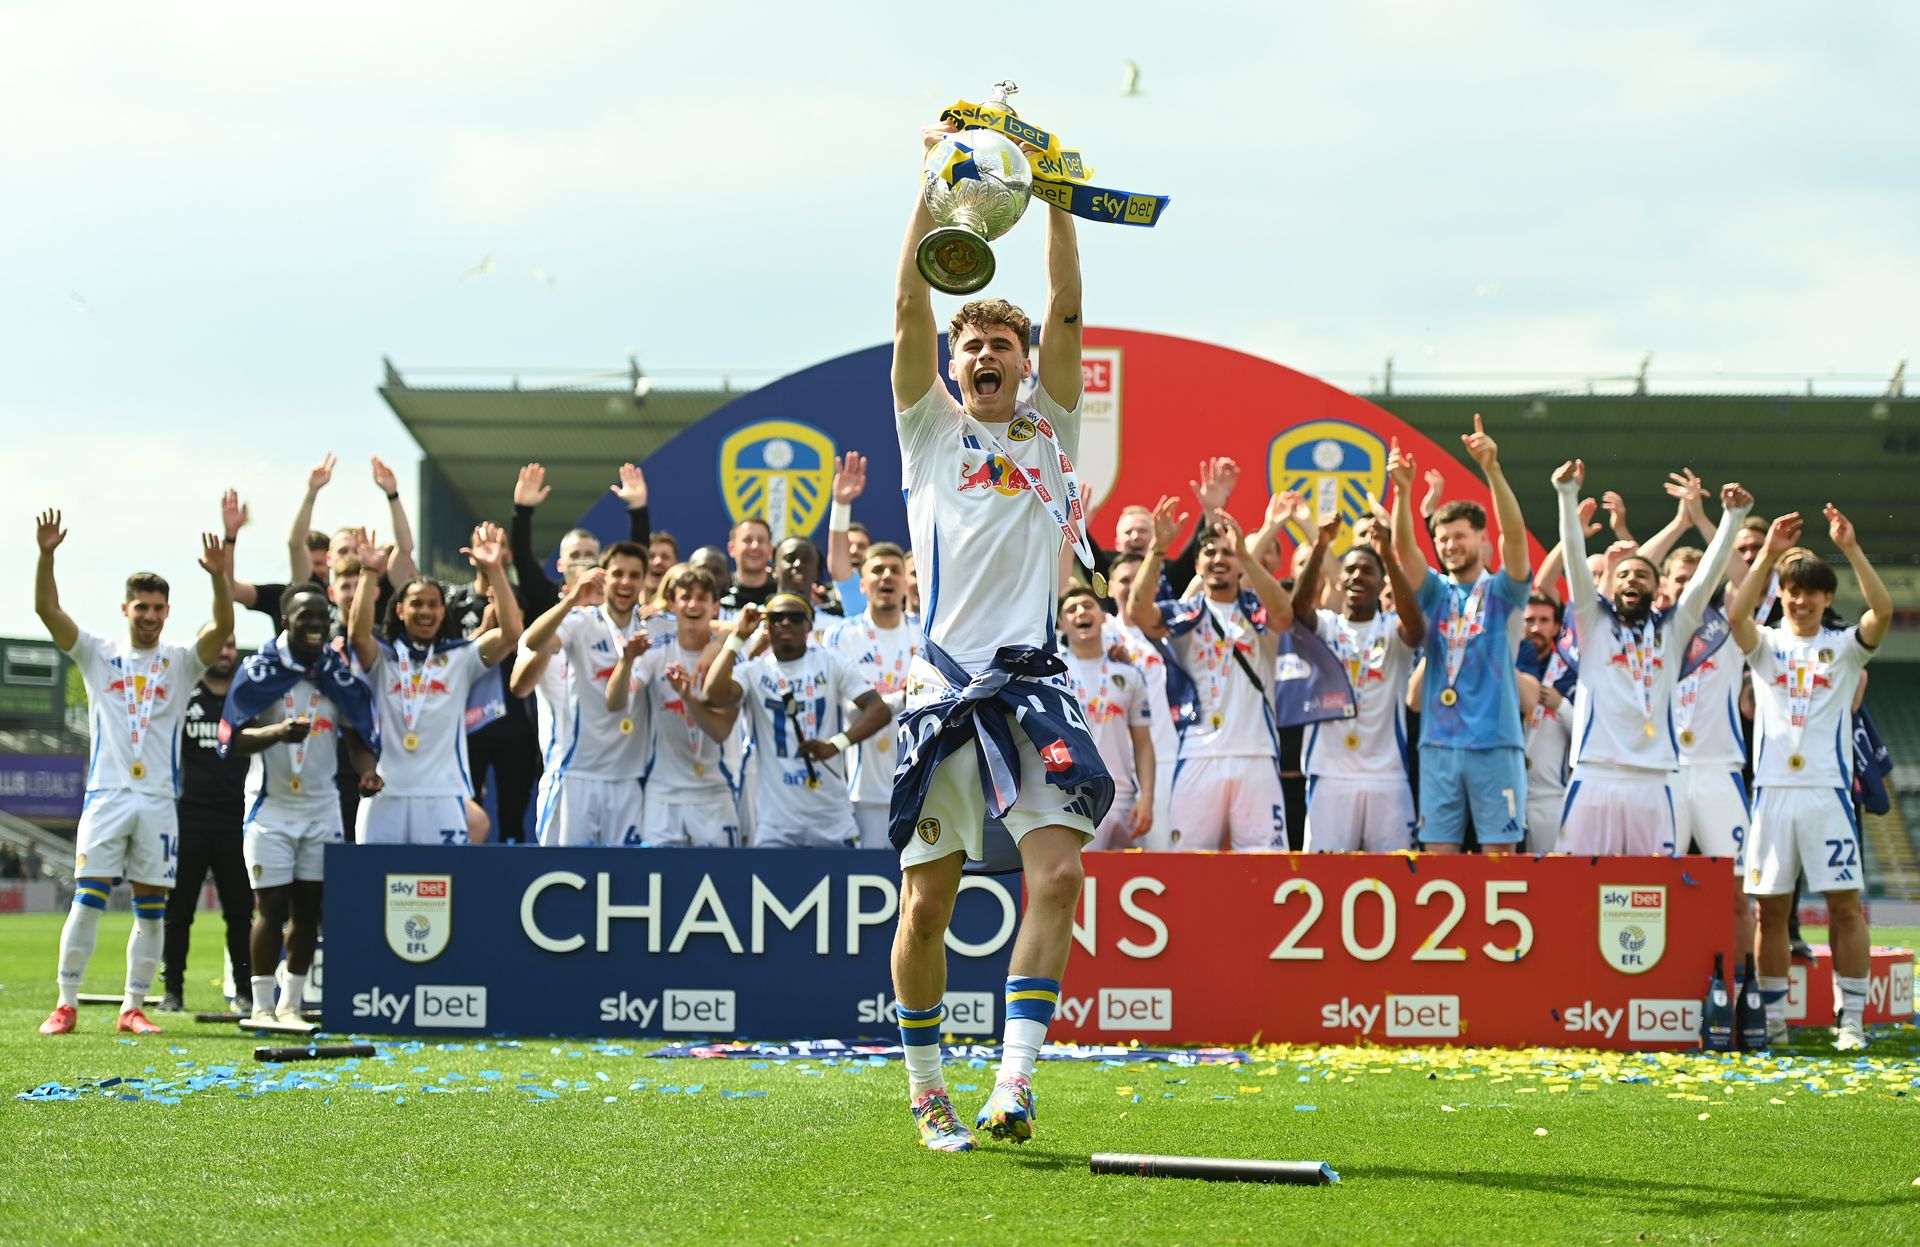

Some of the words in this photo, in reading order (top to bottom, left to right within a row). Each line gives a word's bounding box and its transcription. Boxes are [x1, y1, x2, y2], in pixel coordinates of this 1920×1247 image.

[962, 107, 1001, 126] sky
[1009, 118, 1045, 145] bet
[1037, 155, 1064, 175] sky
[1066, 156, 1083, 174] bet
[1092, 192, 1126, 218] sky
[1129, 195, 1153, 217] bet
[1026, 410, 1040, 424] sky
[1039, 420, 1053, 437] bet
[1038, 484, 1051, 502] bet
[1067, 481, 1077, 499] sky
[1073, 499, 1083, 520] bet
[1052, 509, 1065, 525] sky
[1063, 525, 1077, 543] bet
[186, 721, 218, 739] UNI
[1272, 804, 1283, 831] 5
[1502, 789, 1517, 817] 1
[159, 833, 178, 863] 14
[1731, 825, 1744, 852] 9
[1825, 838, 1857, 868] 22
[390, 880, 415, 897] sky
[419, 882, 446, 895] bet
[1603, 891, 1629, 908] sky
[1633, 892, 1660, 907] bet
[520, 870, 1169, 958] CHAMPONS
[1269, 877, 1534, 963] 2025
[406, 942, 428, 954] EFL
[1621, 953, 1643, 966] EFL
[352, 986, 411, 1024] sky
[422, 989, 478, 1018] bet
[1866, 968, 1889, 1014] ky
[600, 990, 659, 1029] sky
[671, 992, 728, 1022] bet
[857, 991, 898, 1024] sk
[1051, 989, 1095, 1029] ky
[1107, 992, 1164, 1021] bet
[1321, 997, 1381, 1035] sky
[1394, 999, 1451, 1027] bet
[1563, 1000, 1624, 1039] sky
[1637, 1003, 1694, 1032] bet
